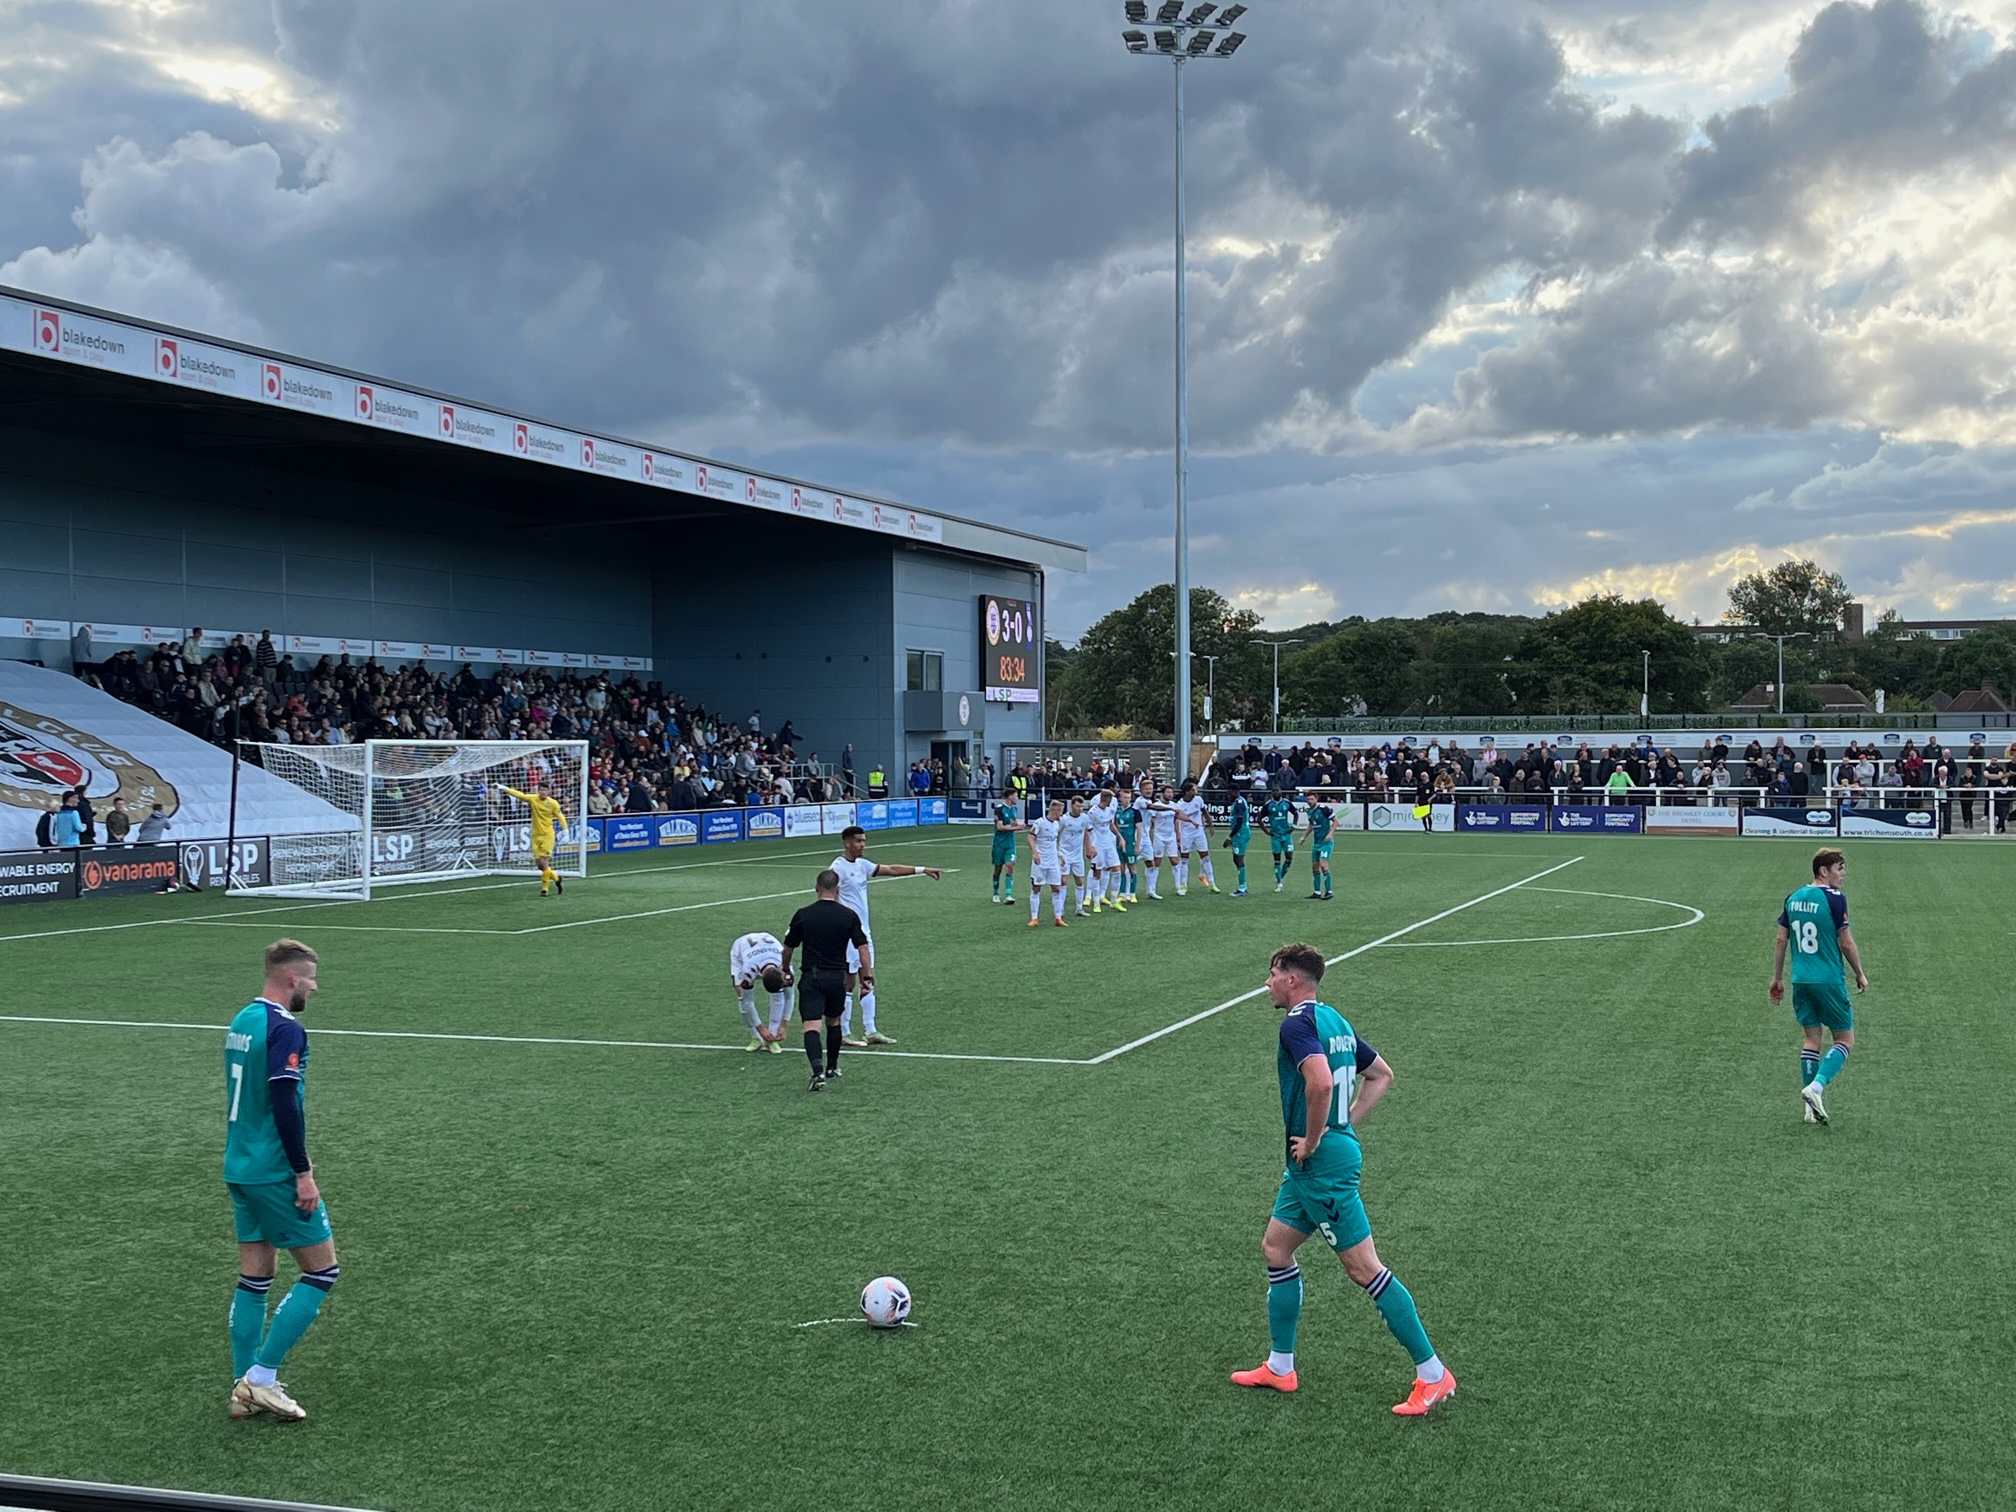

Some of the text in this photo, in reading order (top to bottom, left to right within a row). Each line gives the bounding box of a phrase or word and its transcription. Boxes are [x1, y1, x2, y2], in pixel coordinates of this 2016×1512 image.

[62, 327, 125, 354] blakedown
[180, 354, 235, 380] blakedown
[283, 378, 333, 401] blakedown
[375, 399, 419, 420] blakedown
[456, 418, 496, 437] blakedown
[1000, 656, 1025, 682] 83:34
[209, 843, 258, 875] LSP
[373, 834, 414, 862] LSP
[36, 862, 75, 876] ENERGY
[102, 861, 176, 882] vanarama
[1791, 920, 1818, 954] 18
[229, 1063, 243, 1122] 7
[1319, 1221, 1337, 1246] 5
